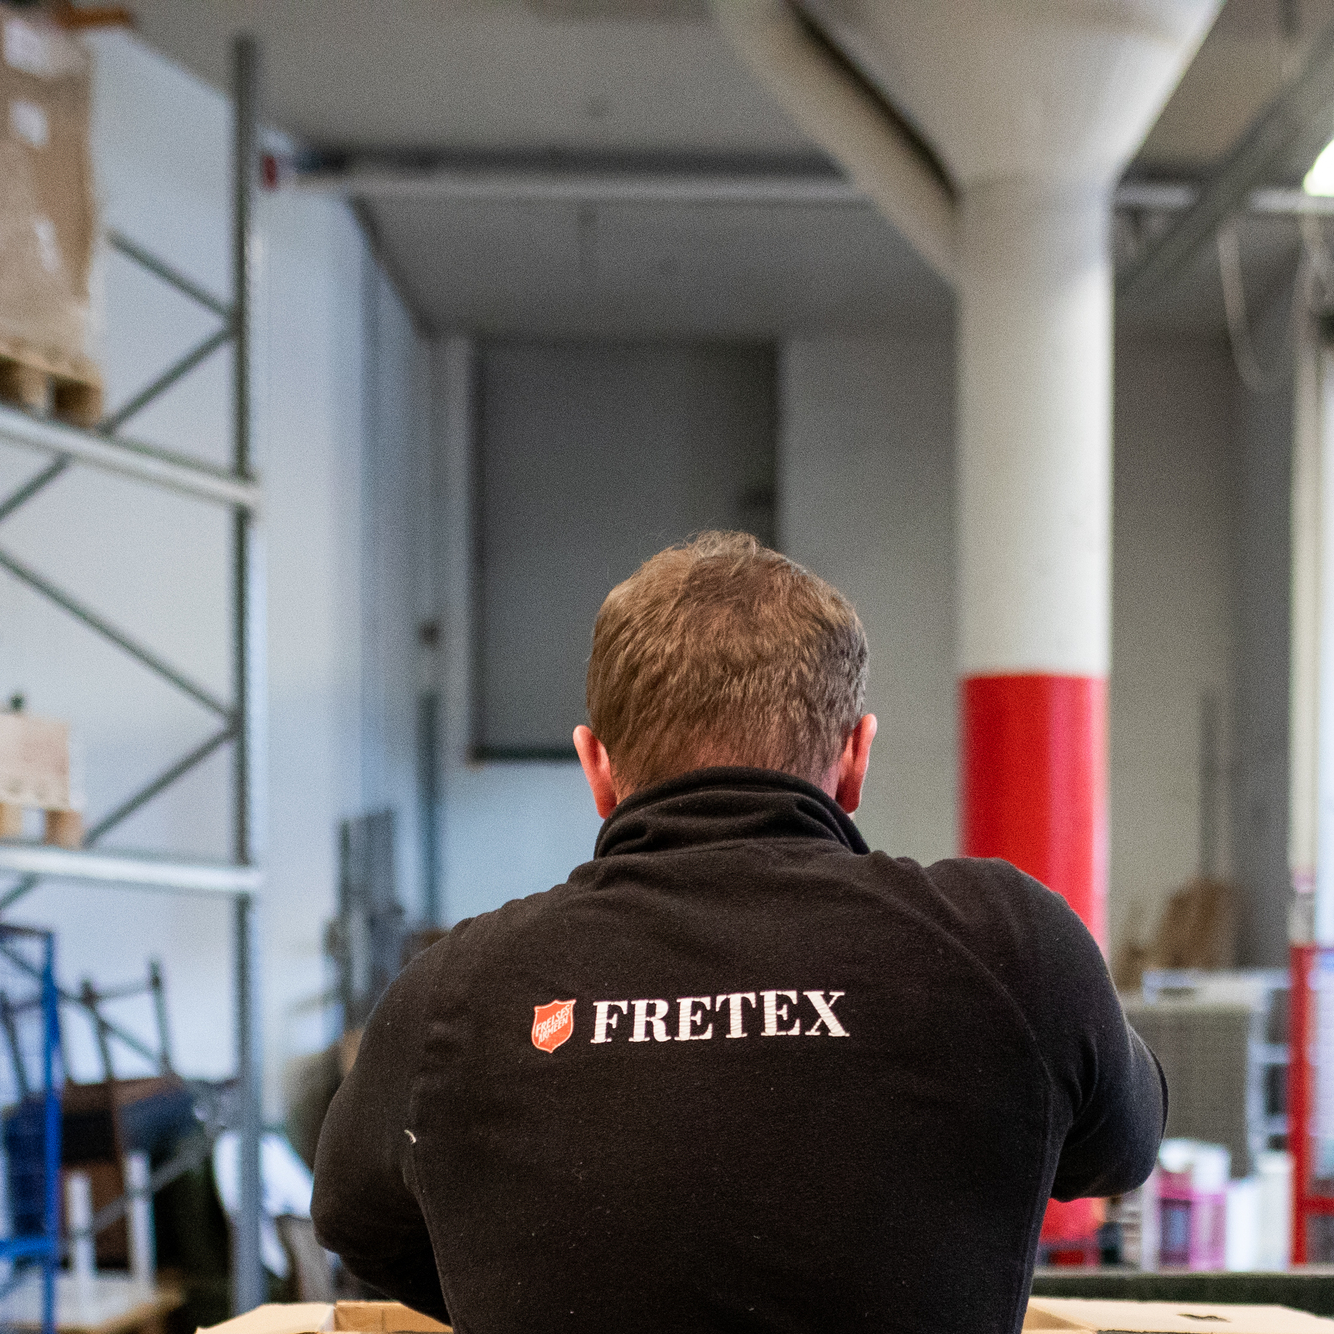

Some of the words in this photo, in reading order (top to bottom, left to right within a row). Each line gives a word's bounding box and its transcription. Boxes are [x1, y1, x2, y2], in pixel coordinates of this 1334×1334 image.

[535, 1004, 571, 1038] FRELSES
[538, 1013, 568, 1046] ARMEEN
[589, 990, 851, 1044] FRETEX
